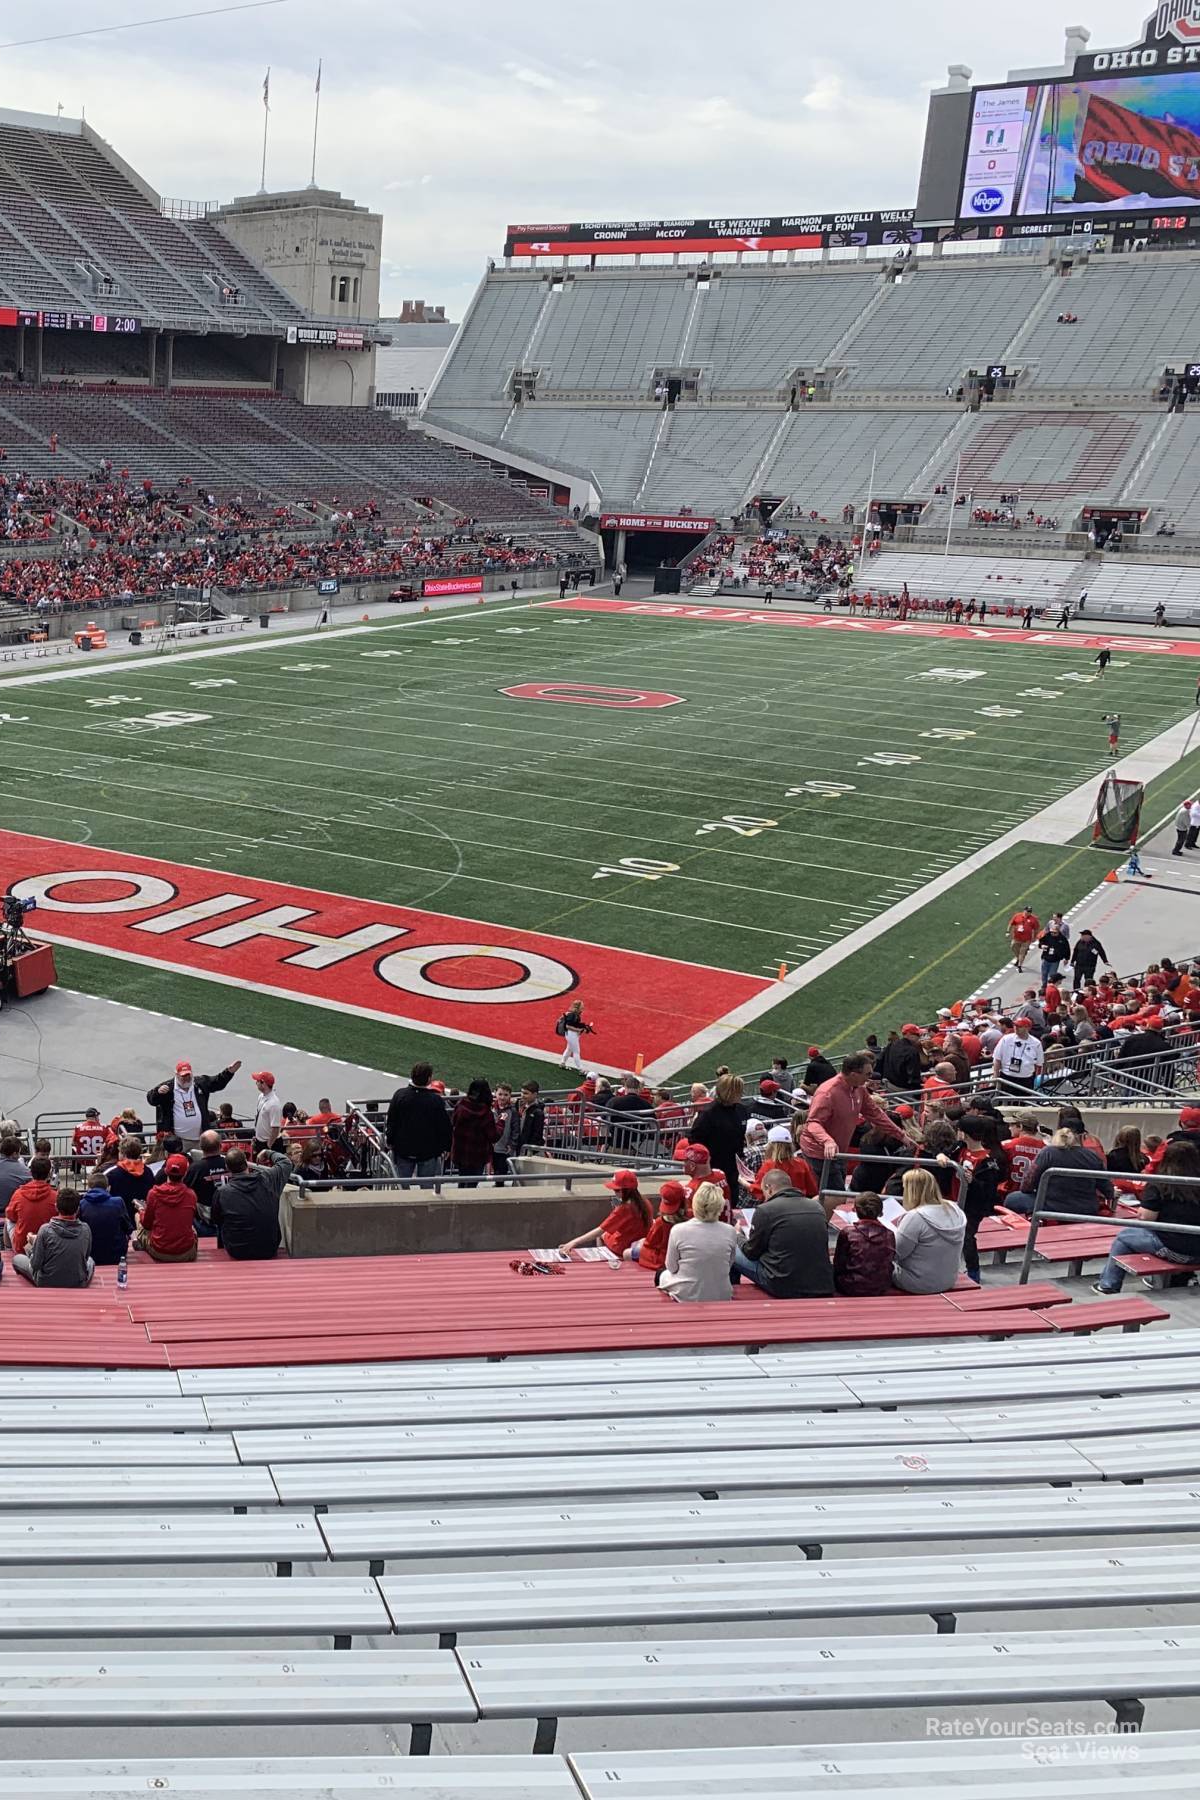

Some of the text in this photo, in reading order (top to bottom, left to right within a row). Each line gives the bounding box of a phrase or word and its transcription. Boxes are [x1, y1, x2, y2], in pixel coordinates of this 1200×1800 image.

[1093, 49, 1158, 71] OHIO
[973, 192, 1002, 211] Kroger
[834, 213, 874, 223] COVELLI
[880, 211, 914, 220] WELLS
[708, 219, 771, 229] LES WEXNER
[782, 216, 822, 226] HARMON
[717, 227, 763, 236] WANDELL
[800, 223, 855, 233] WOLFE FDN
[995, 225, 1004, 237] 0
[1021, 224, 1053, 234] SCARLET
[594, 231, 627, 240] CRONIN
[655, 229, 686, 238] McCOY
[115, 317, 136, 331] 2:00
[990, 367, 1002, 377] 25
[620, 518, 646, 527] HOME
[663, 520, 710, 530] BUCKEYES
[623, 605, 1177, 650] BUCKEYES
[865, 751, 922, 766] 40
[793, 780, 856, 797] 30
[704, 814, 778, 837] 20
[601, 857, 681, 881] 10
[6, 869, 580, 1004] OHIO
[80, 1135, 104, 1155] 36
[1163, 1639, 1180, 1648] 15
[992, 1645, 1010, 1653] 14
[643, 1655, 660, 1664] 12
[819, 1650, 836, 1659] 13
[282, 1664, 296, 1674] 10
[469, 1660, 483, 1669] 11
[98, 1665, 107, 1675] 9
[820, 1763, 842, 1774] 12
[604, 1770, 622, 1781] 11
[153, 1778, 165, 1789] 9
